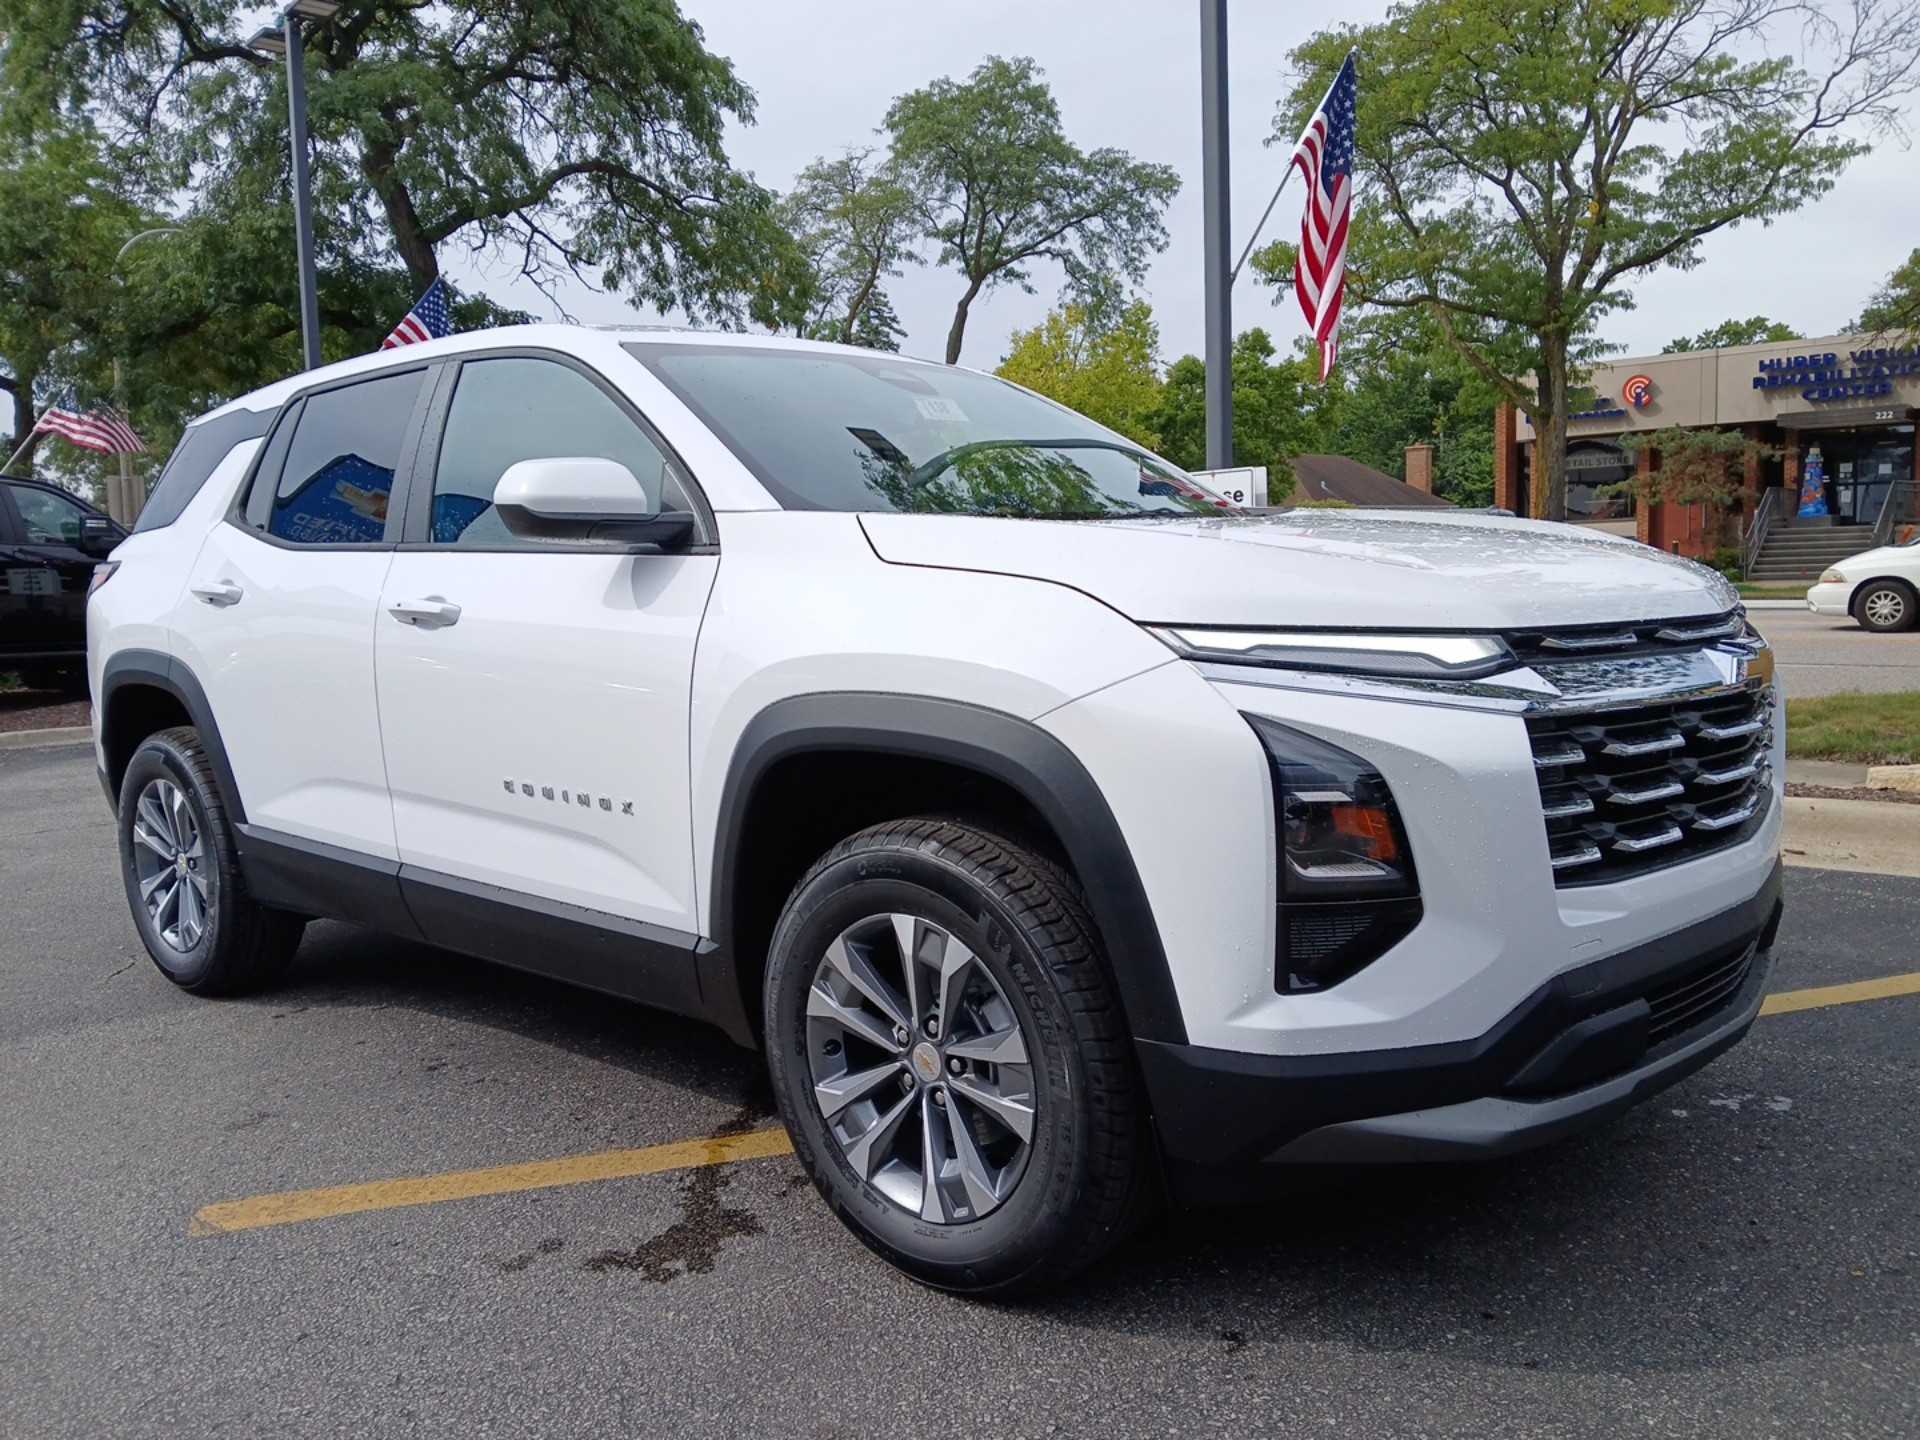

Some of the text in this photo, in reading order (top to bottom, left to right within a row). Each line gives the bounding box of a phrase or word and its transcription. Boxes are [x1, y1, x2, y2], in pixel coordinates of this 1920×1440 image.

[1759, 346, 1920, 372] HUBER VISIO
[1802, 382, 1893, 400] CENTER
[1875, 410, 1894, 420] 222
[1567, 456, 1630, 467] ETAIL STORE
[1223, 490, 1244, 502] se
[503, 778, 635, 817] EQUINOX
[1011, 962, 1065, 1088] MICHELIN
